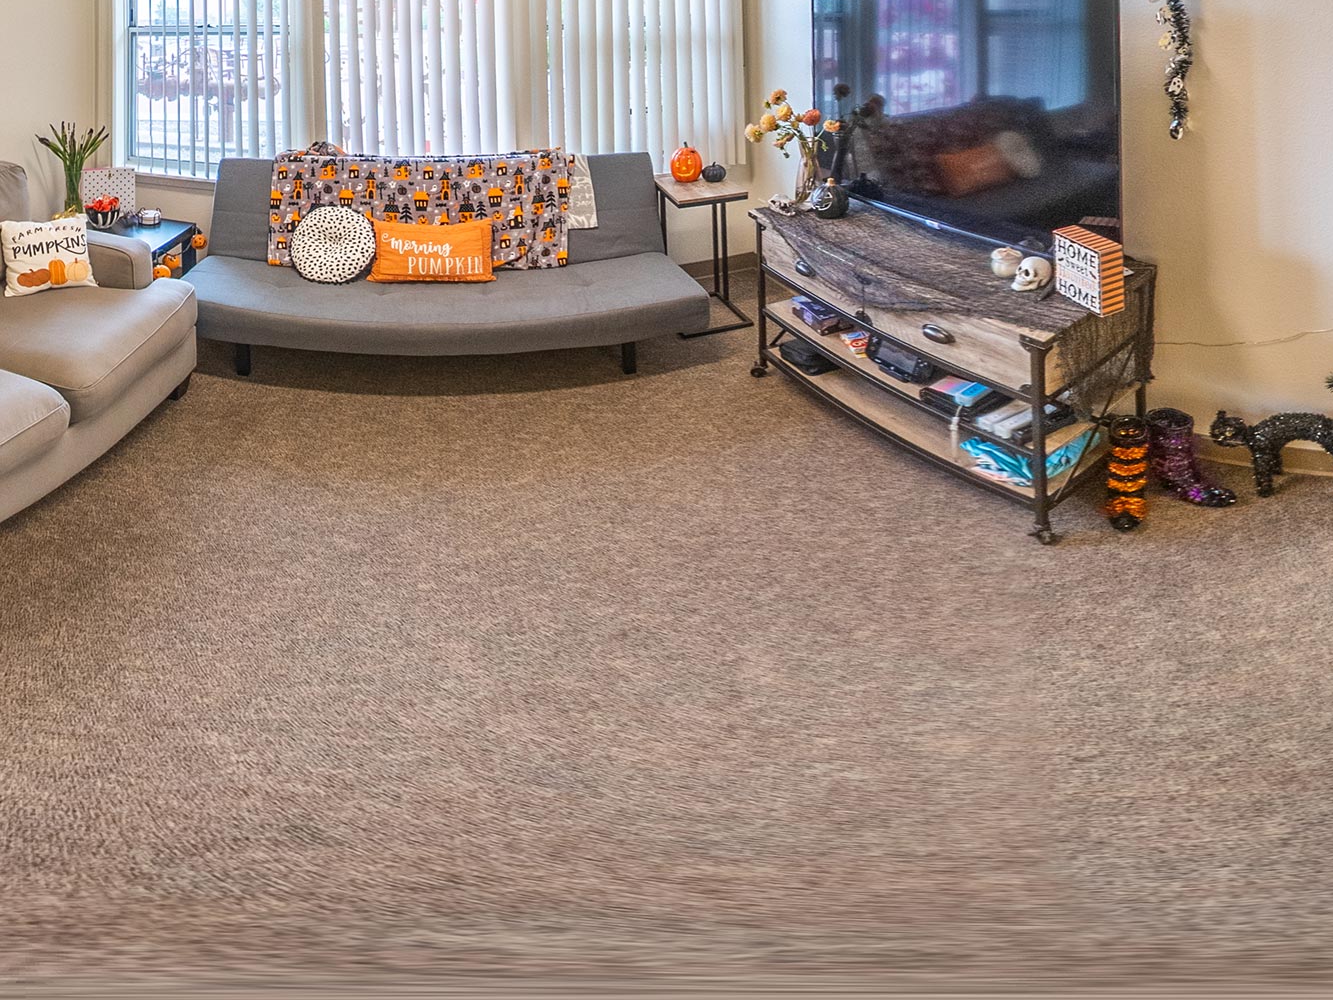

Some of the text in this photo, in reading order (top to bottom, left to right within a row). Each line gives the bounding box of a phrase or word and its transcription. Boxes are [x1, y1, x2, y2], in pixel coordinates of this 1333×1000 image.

[12, 226, 43, 243] FARM
[12, 234, 87, 259] PUMPKINS
[407, 255, 484, 275] PUMPKIN
[1057, 238, 1097, 269] HOME
[1059, 278, 1098, 309] HOME
